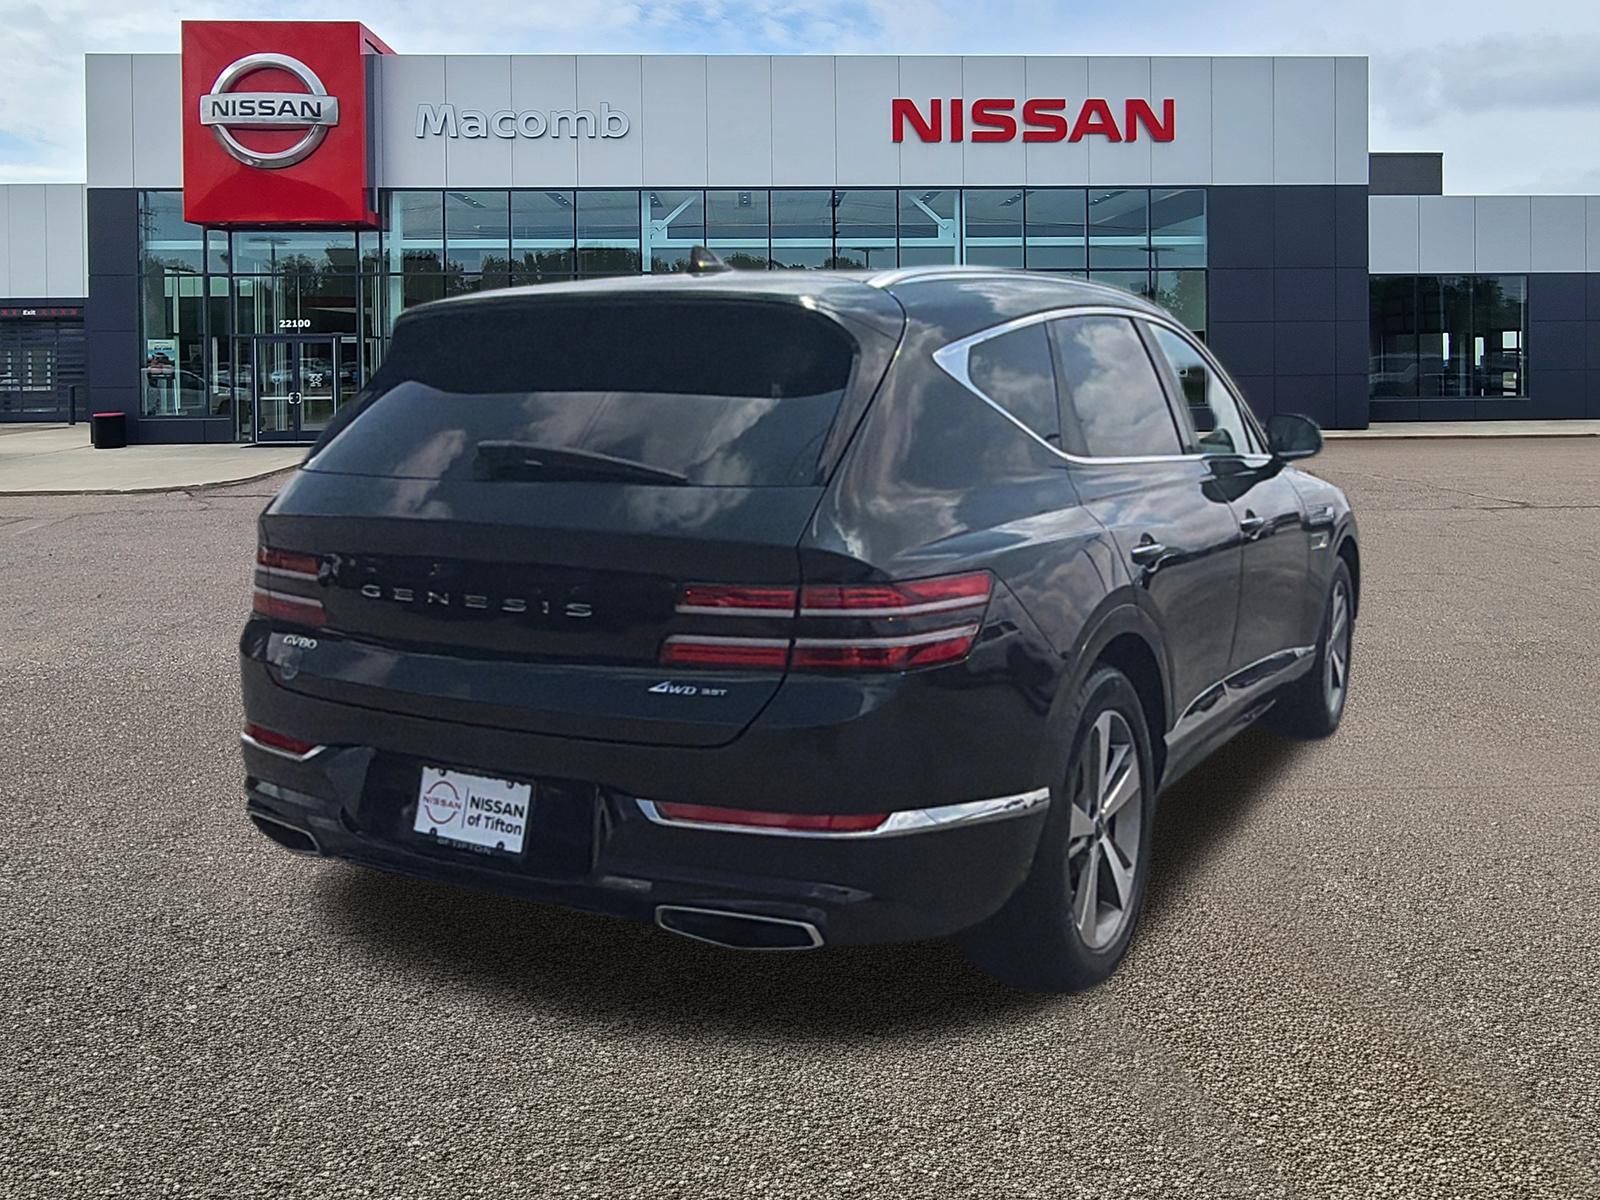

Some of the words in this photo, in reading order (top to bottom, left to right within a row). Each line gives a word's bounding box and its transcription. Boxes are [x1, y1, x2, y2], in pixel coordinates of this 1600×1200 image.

[211, 100, 322, 117] NISSAN
[415, 101, 630, 139] Macomb
[892, 98, 1175, 142] NISSAN
[279, 319, 311, 328] 22100
[360, 584, 593, 618] GENESIS
[283, 634, 318, 650] GV80
[648, 681, 697, 695] 4WD
[423, 796, 462, 811] NISSAN
[469, 795, 525, 819] NISSAN
[467, 814, 482, 828] of
[484, 815, 522, 837] Tifton
